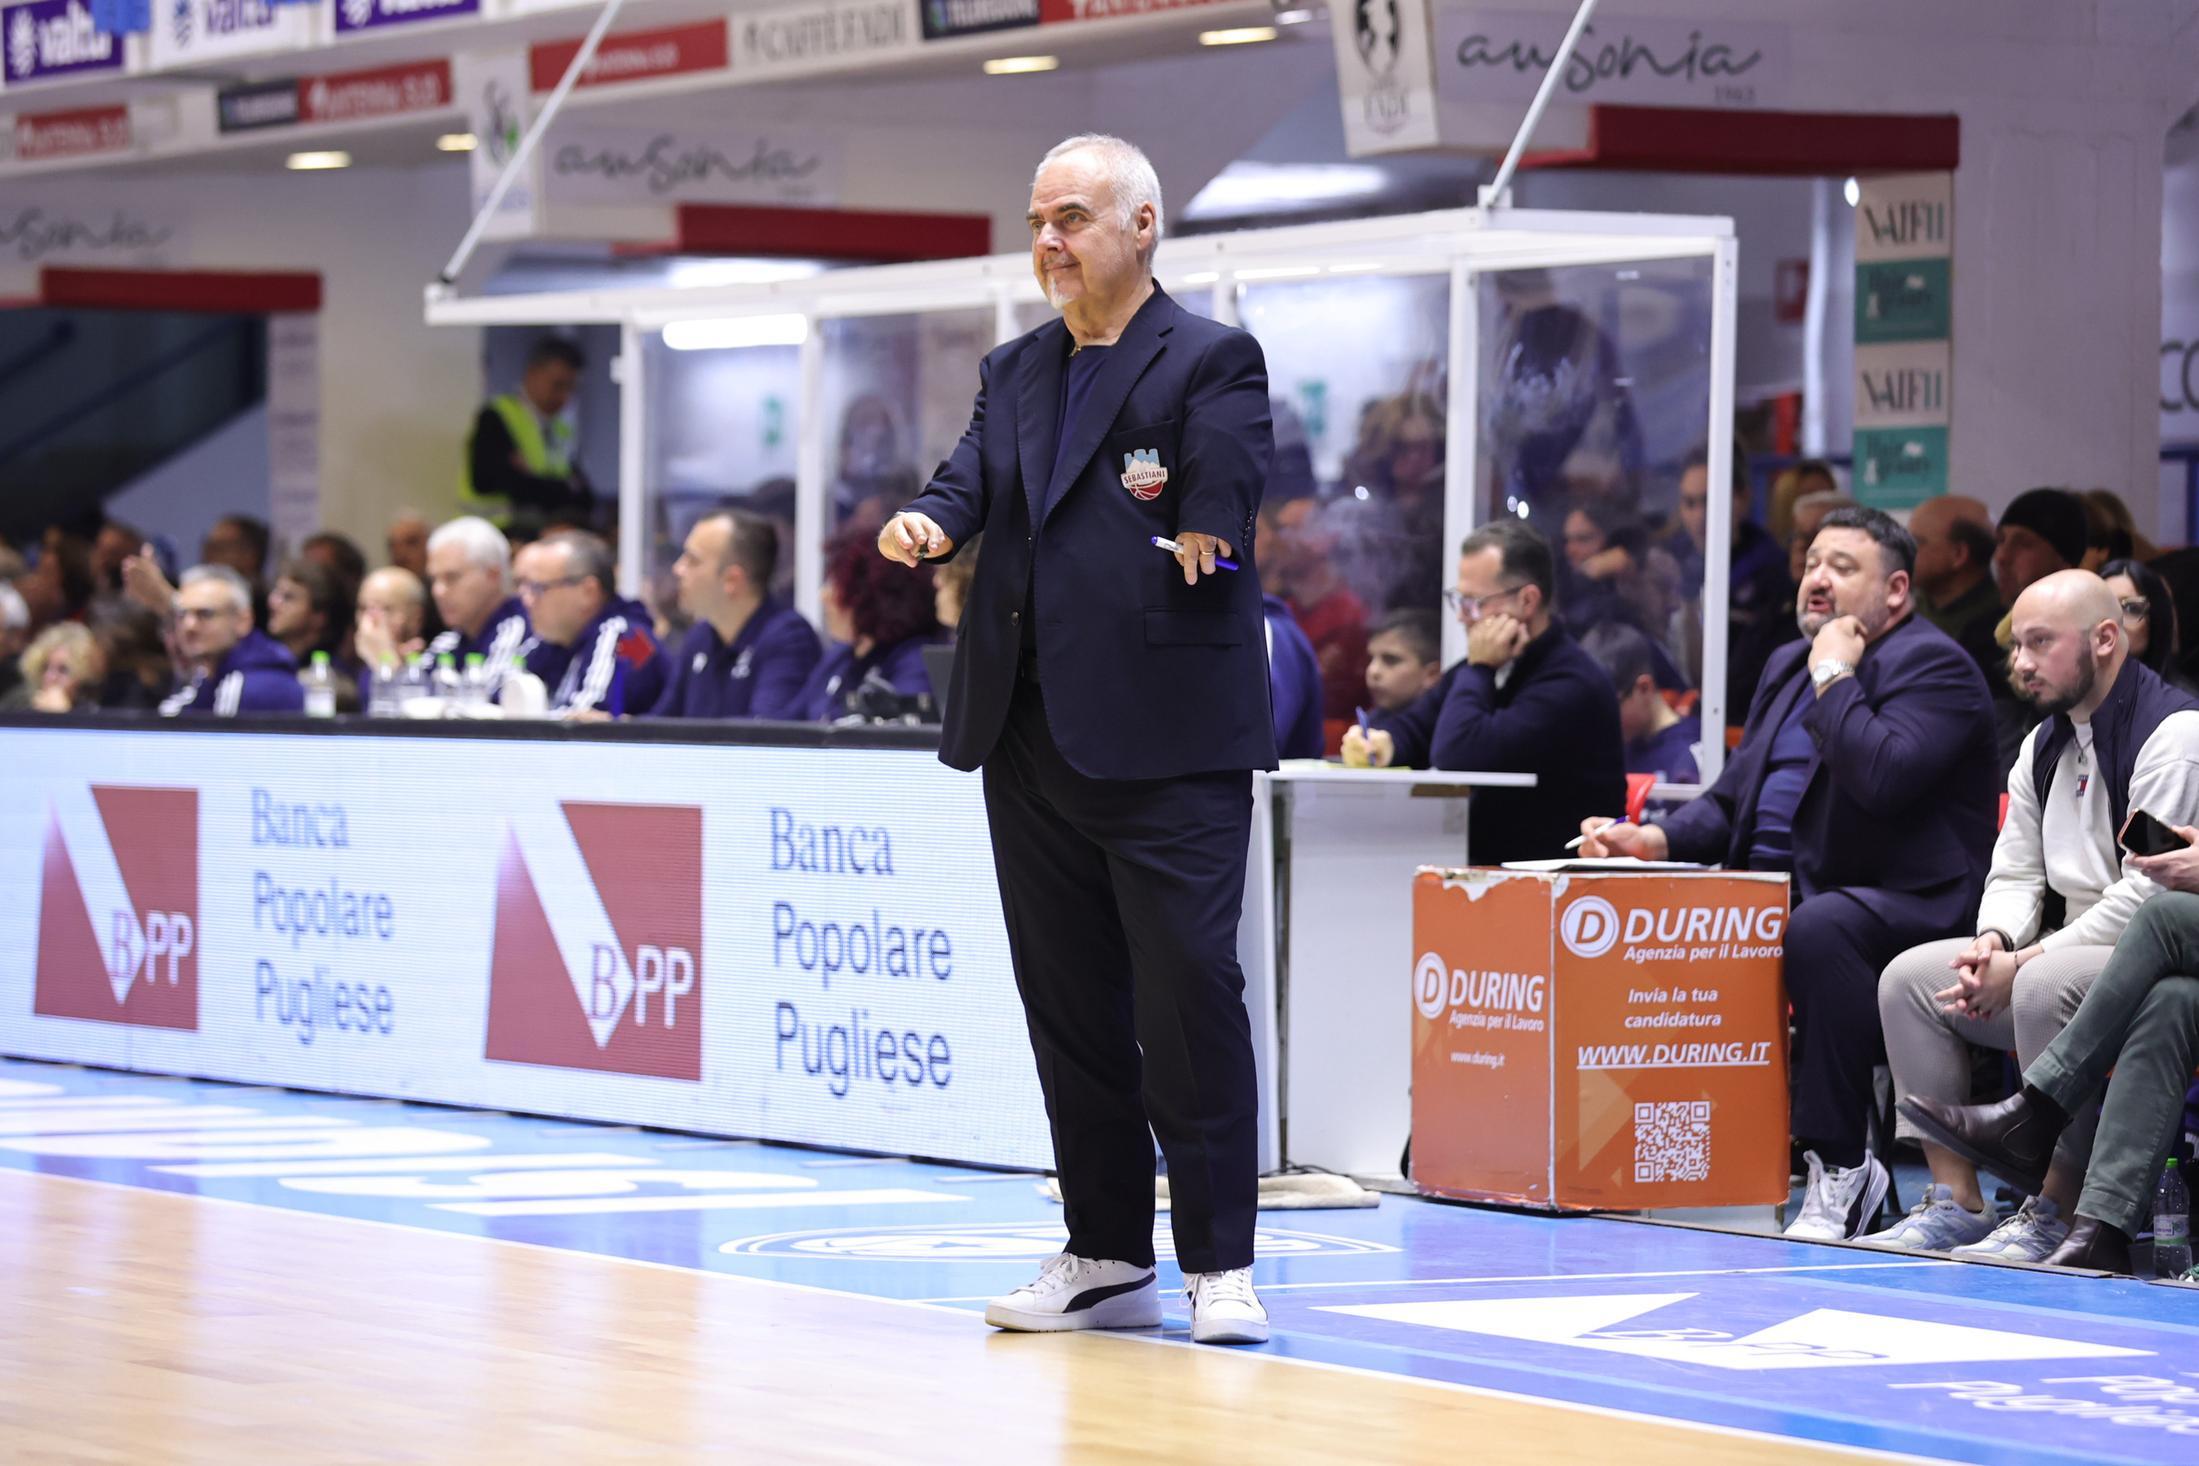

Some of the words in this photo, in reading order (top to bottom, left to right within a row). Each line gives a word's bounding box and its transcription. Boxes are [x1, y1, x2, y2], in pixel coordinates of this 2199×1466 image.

[1124, 470, 1165, 483] SEBASTIANI
[252, 786, 349, 847] Banca
[770, 806, 894, 875] Banca
[254, 870, 393, 948] Popolare
[1623, 906, 1784, 943] DURING
[109, 909, 195, 987] BPP
[774, 901, 952, 990] Popolare
[1623, 945, 1685, 964] Agenzia
[1689, 947, 1716, 962] per
[1719, 943, 1728, 960] il
[1732, 943, 1784, 959] Lavoro
[256, 958, 394, 1046] Pugliese
[588, 943, 696, 1030] BPP
[1448, 969, 1545, 1012] DURING
[1628, 988, 1667, 1003] Invia
[1672, 987, 1687, 1002] la
[1692, 988, 1718, 1002] tua
[1449, 1009, 1486, 1030] Agenzia
[1487, 1015, 1503, 1031] per
[1504, 1012, 1512, 1029] il
[1512, 1014, 1544, 1032] Lavoro
[1625, 1012, 1722, 1028] candidatura
[775, 1002, 952, 1099] Pugliese
[1451, 1051, 1505, 1069] www.during.it
[1577, 1042, 1771, 1069] WWW.DURING.IT
